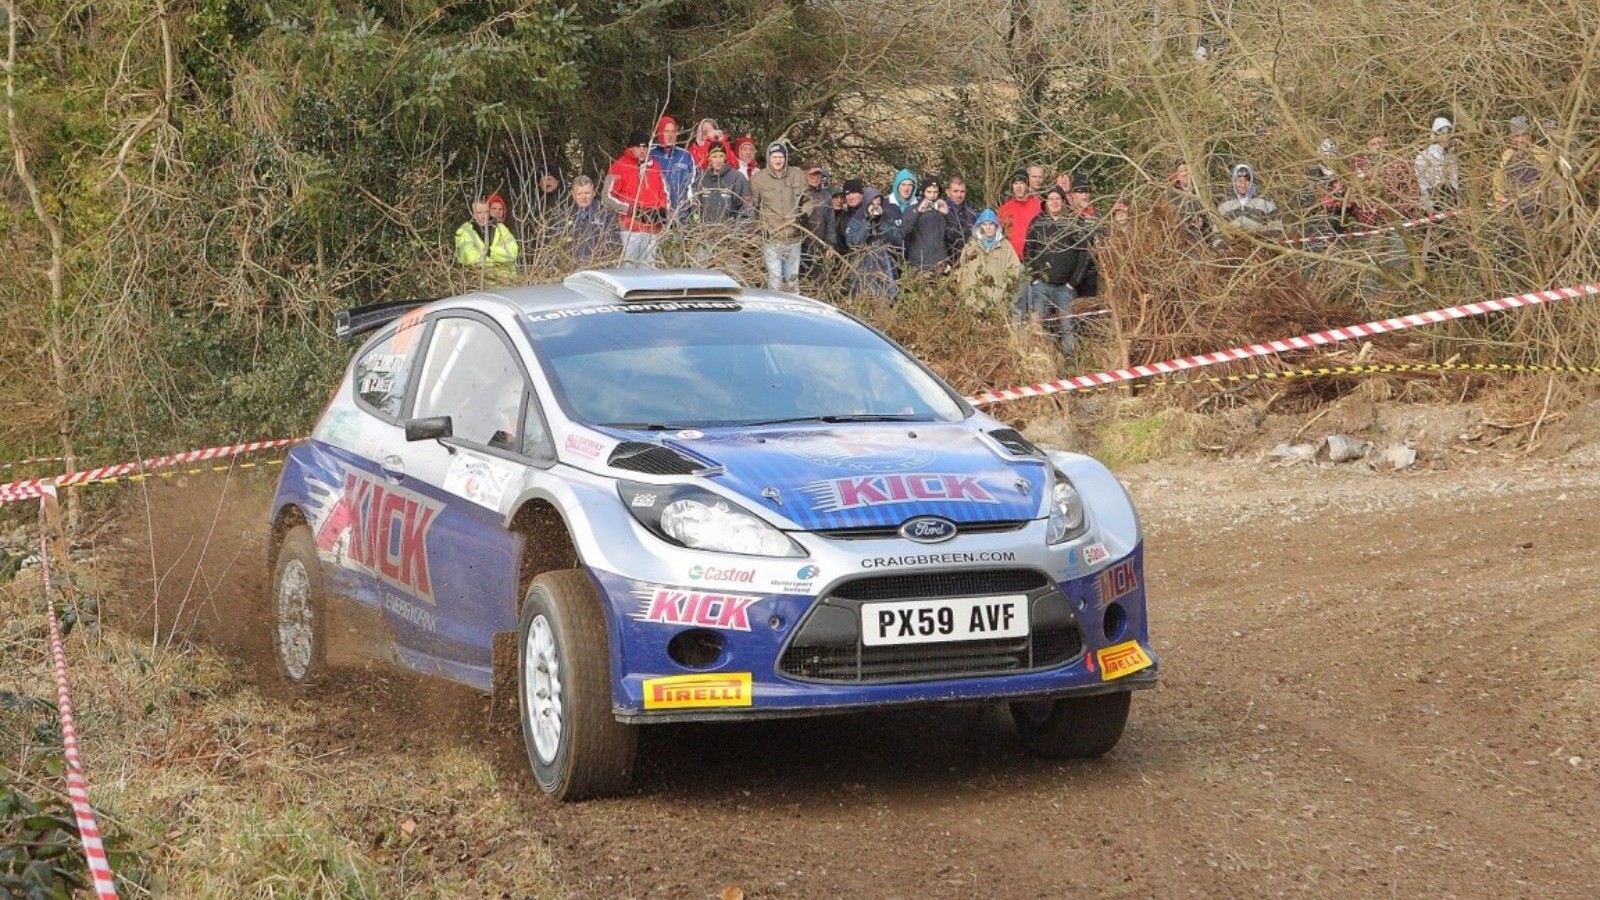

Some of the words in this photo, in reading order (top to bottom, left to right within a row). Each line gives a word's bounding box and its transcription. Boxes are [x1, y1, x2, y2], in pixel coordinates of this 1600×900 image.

[836, 474, 994, 506] KICK
[318, 472, 434, 596] KICK
[914, 521, 945, 536] Ford
[703, 565, 756, 583] Castrol
[861, 551, 1016, 568] CRAIGBREEN.COM
[1099, 560, 1138, 604] KICK
[649, 590, 749, 629] KICK
[878, 606, 954, 638] PX59
[969, 603, 1015, 633] AVF
[1101, 646, 1145, 674] PIRELLI
[652, 679, 742, 702] PIRELLI
